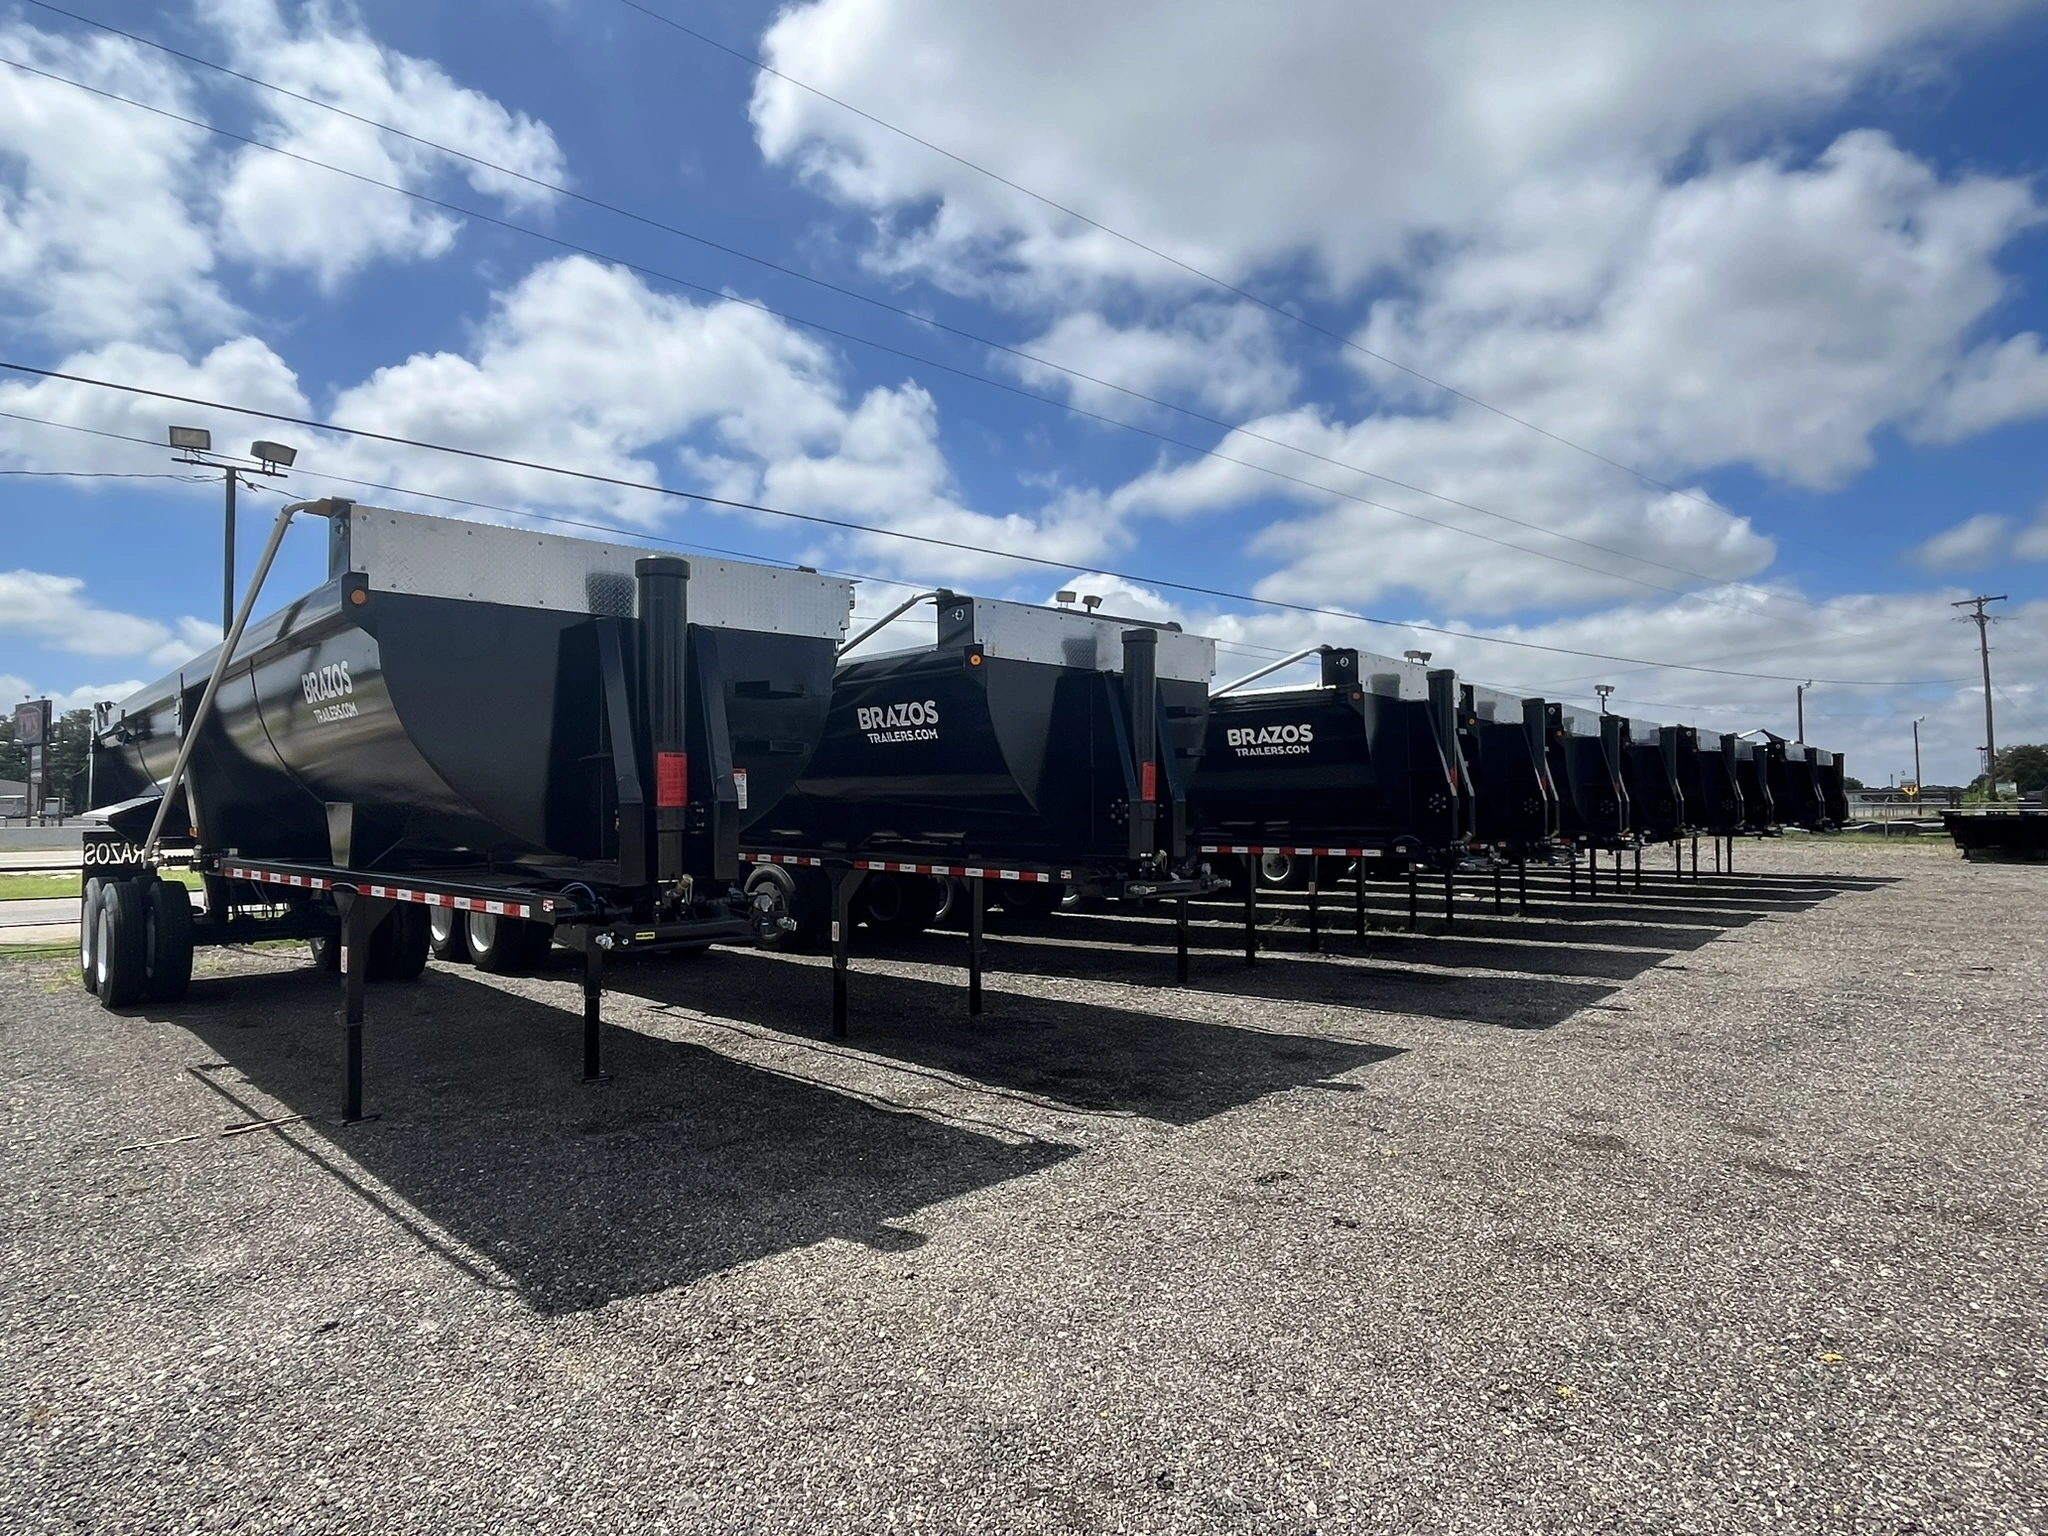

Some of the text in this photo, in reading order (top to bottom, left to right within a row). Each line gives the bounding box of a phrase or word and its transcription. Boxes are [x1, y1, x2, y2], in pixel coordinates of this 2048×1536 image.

[301, 660, 352, 704] BRAZOS
[313, 701, 359, 723] TRAILERS.COM
[857, 700, 939, 729] BRAZOS
[867, 728, 939, 743] TRAILERS.COM
[1227, 724, 1313, 746] BRAZOS
[1235, 745, 1310, 757] TRAILERS.COM
